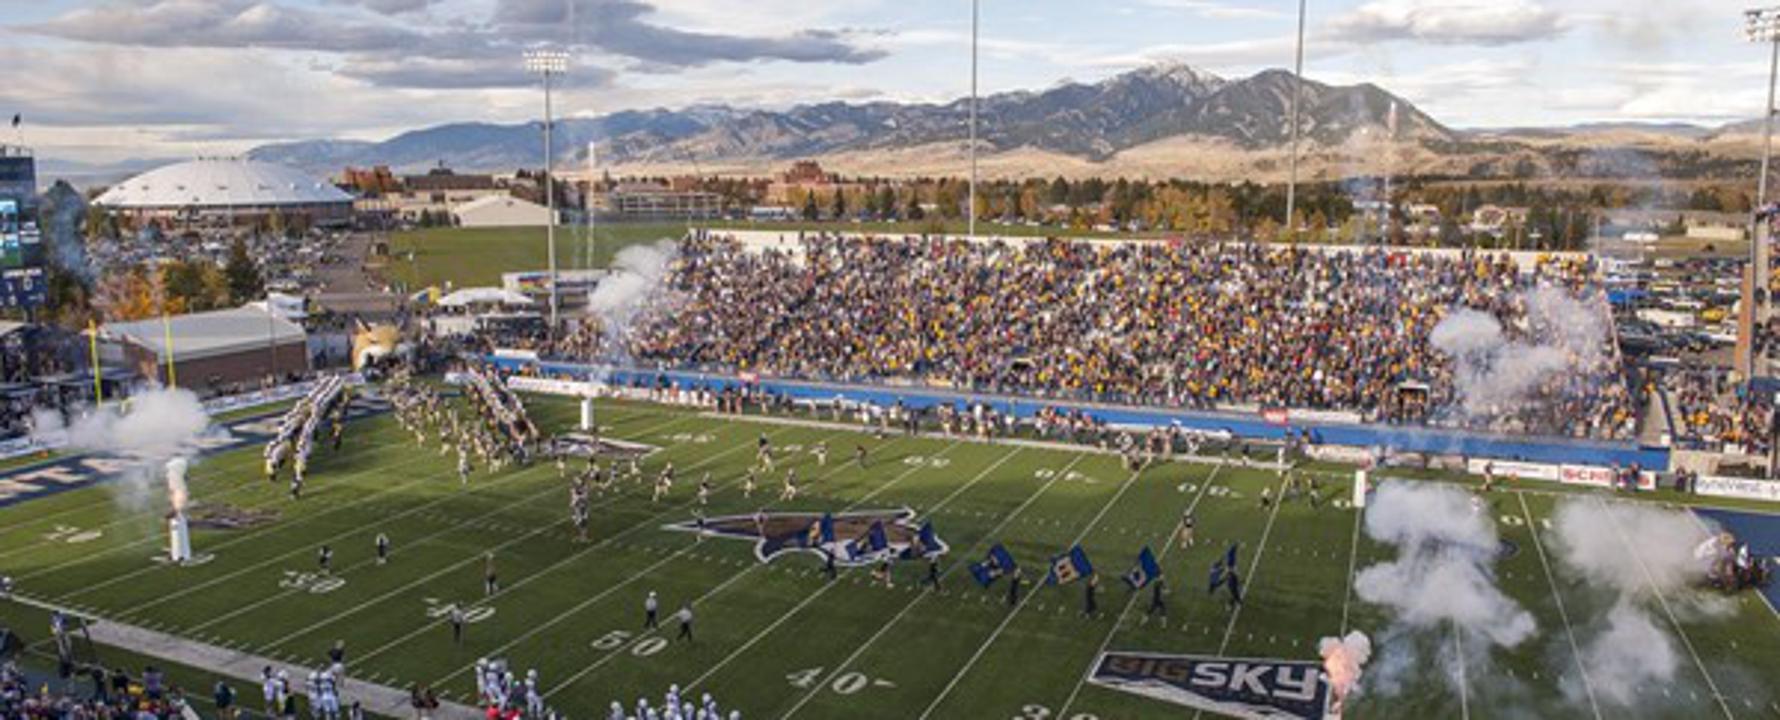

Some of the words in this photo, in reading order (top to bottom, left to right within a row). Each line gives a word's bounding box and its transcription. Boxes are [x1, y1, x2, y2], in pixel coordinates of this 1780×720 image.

[590, 629, 668, 656] 50
[786, 667, 868, 694] 40
[1107, 656, 1190, 679] BIG
[1191, 661, 1319, 701] SKY
